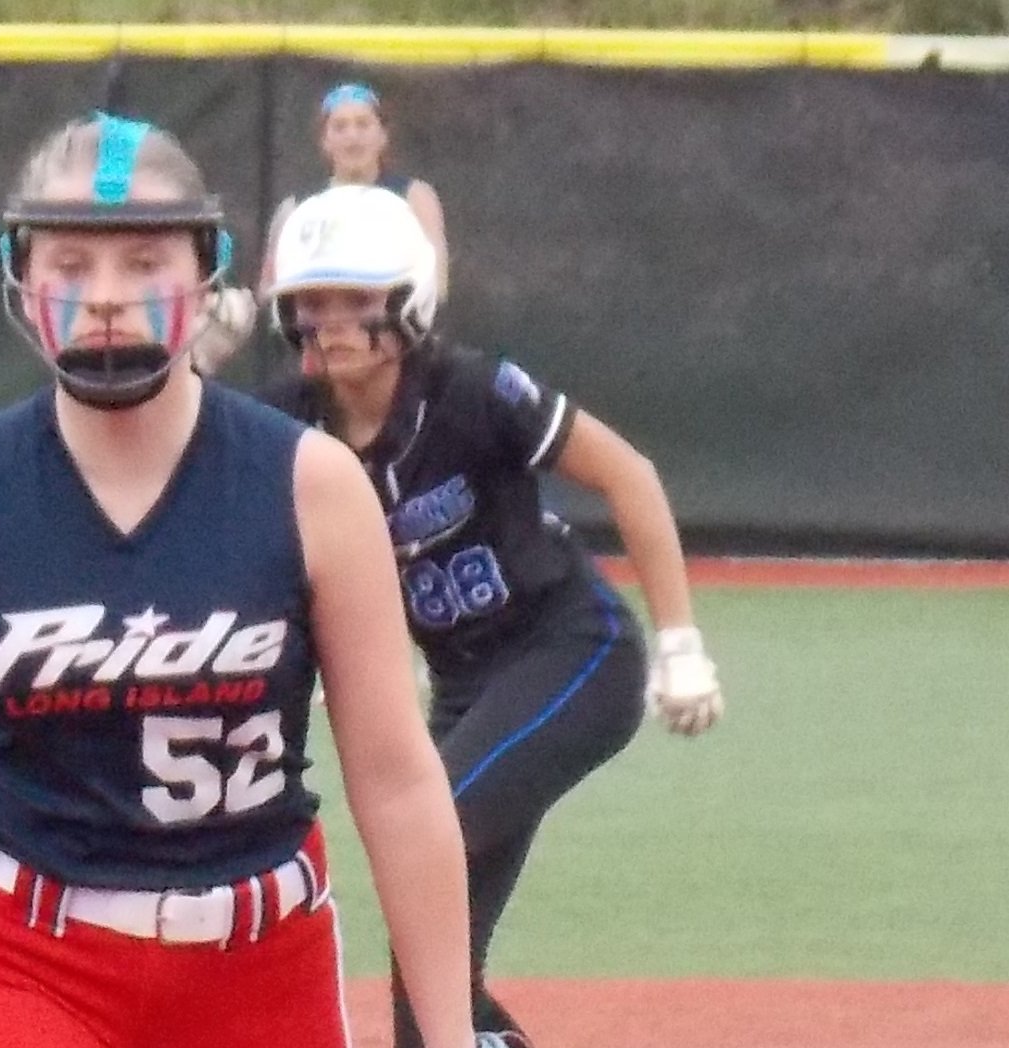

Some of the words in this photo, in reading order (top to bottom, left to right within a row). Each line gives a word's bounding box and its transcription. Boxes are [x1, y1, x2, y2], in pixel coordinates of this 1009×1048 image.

[403, 545, 510, 625] 88
[5, 686, 112, 718] LONG
[142, 709, 286, 824] 52
